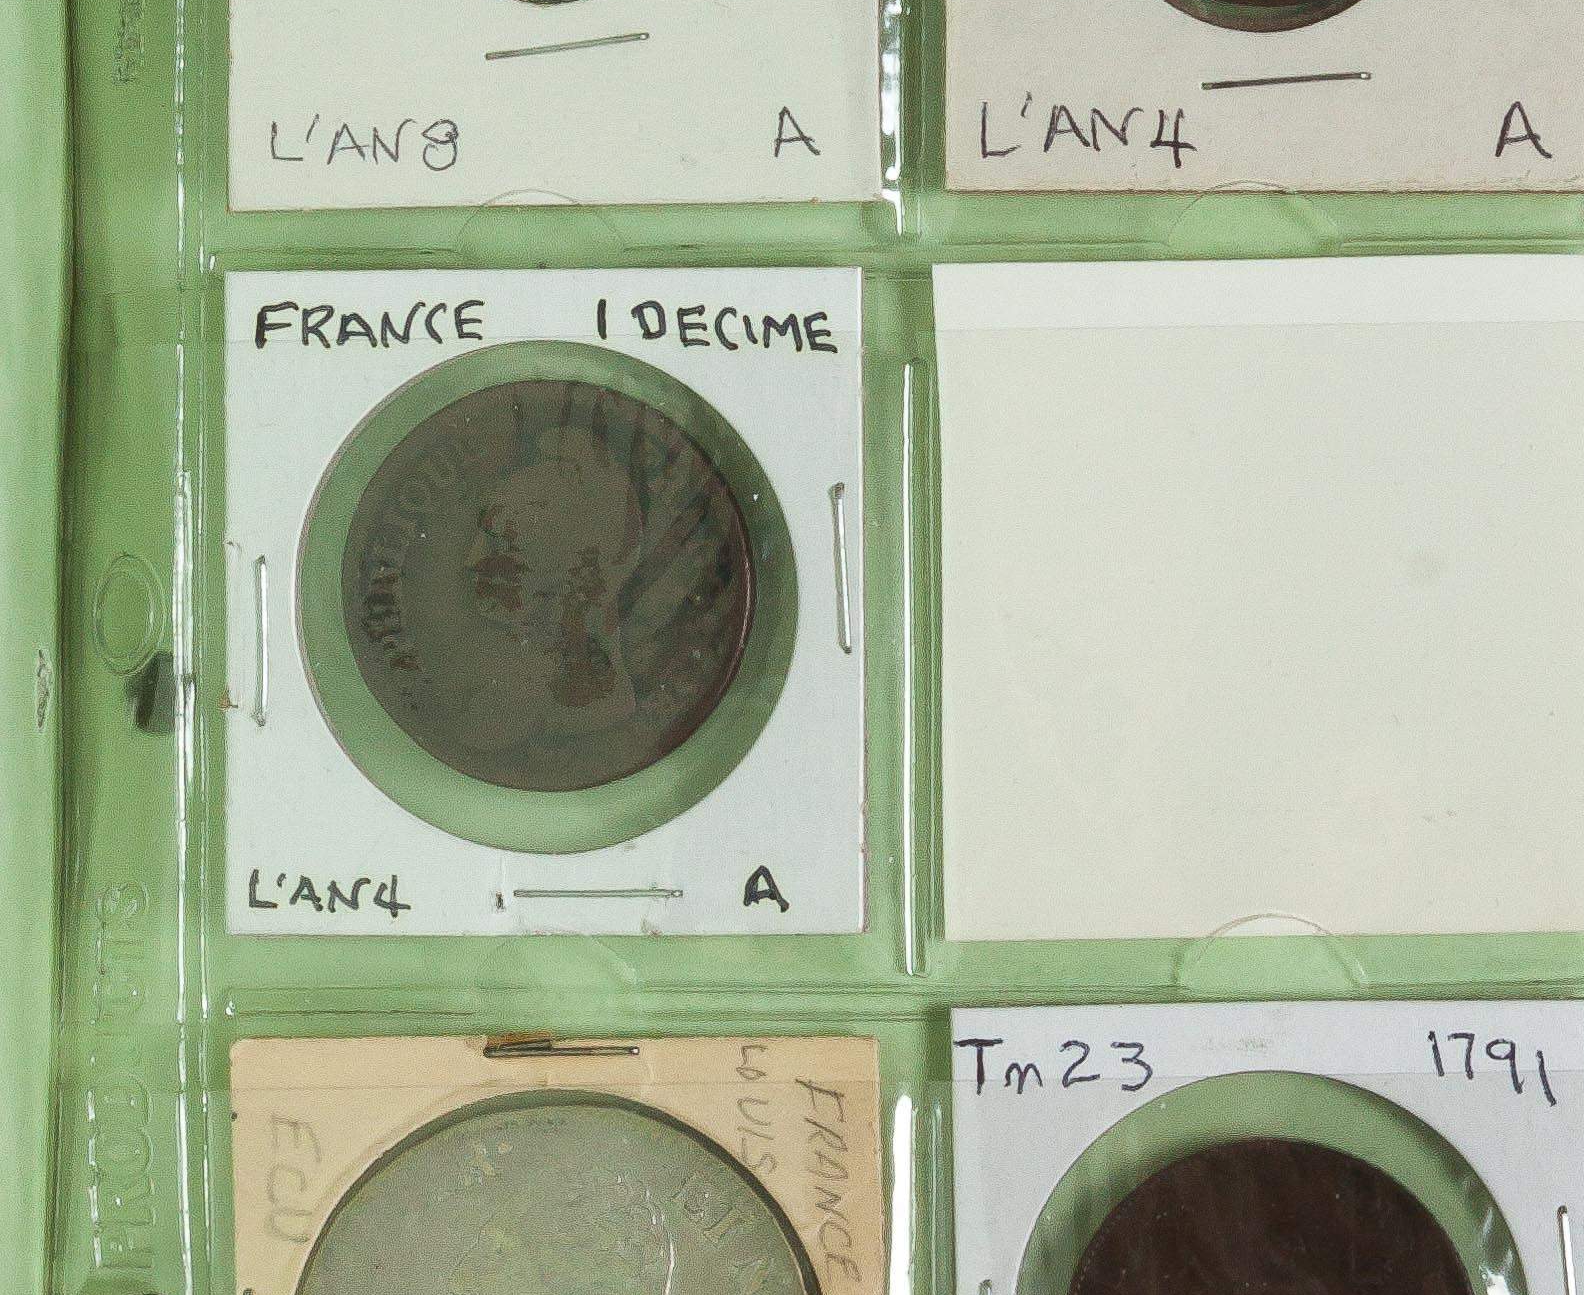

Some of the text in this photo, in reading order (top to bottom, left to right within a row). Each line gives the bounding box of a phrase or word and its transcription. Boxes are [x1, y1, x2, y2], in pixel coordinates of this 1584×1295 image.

[773, 105, 821, 159] A
[1494, 100, 1553, 160] A
[254, 299, 486, 357] FRANCE
[630, 299, 839, 355] DECIME
[742, 864, 790, 914] A
[1427, 1030, 1558, 1108] 1791
[793, 1076, 863, 1284] FRANCE
